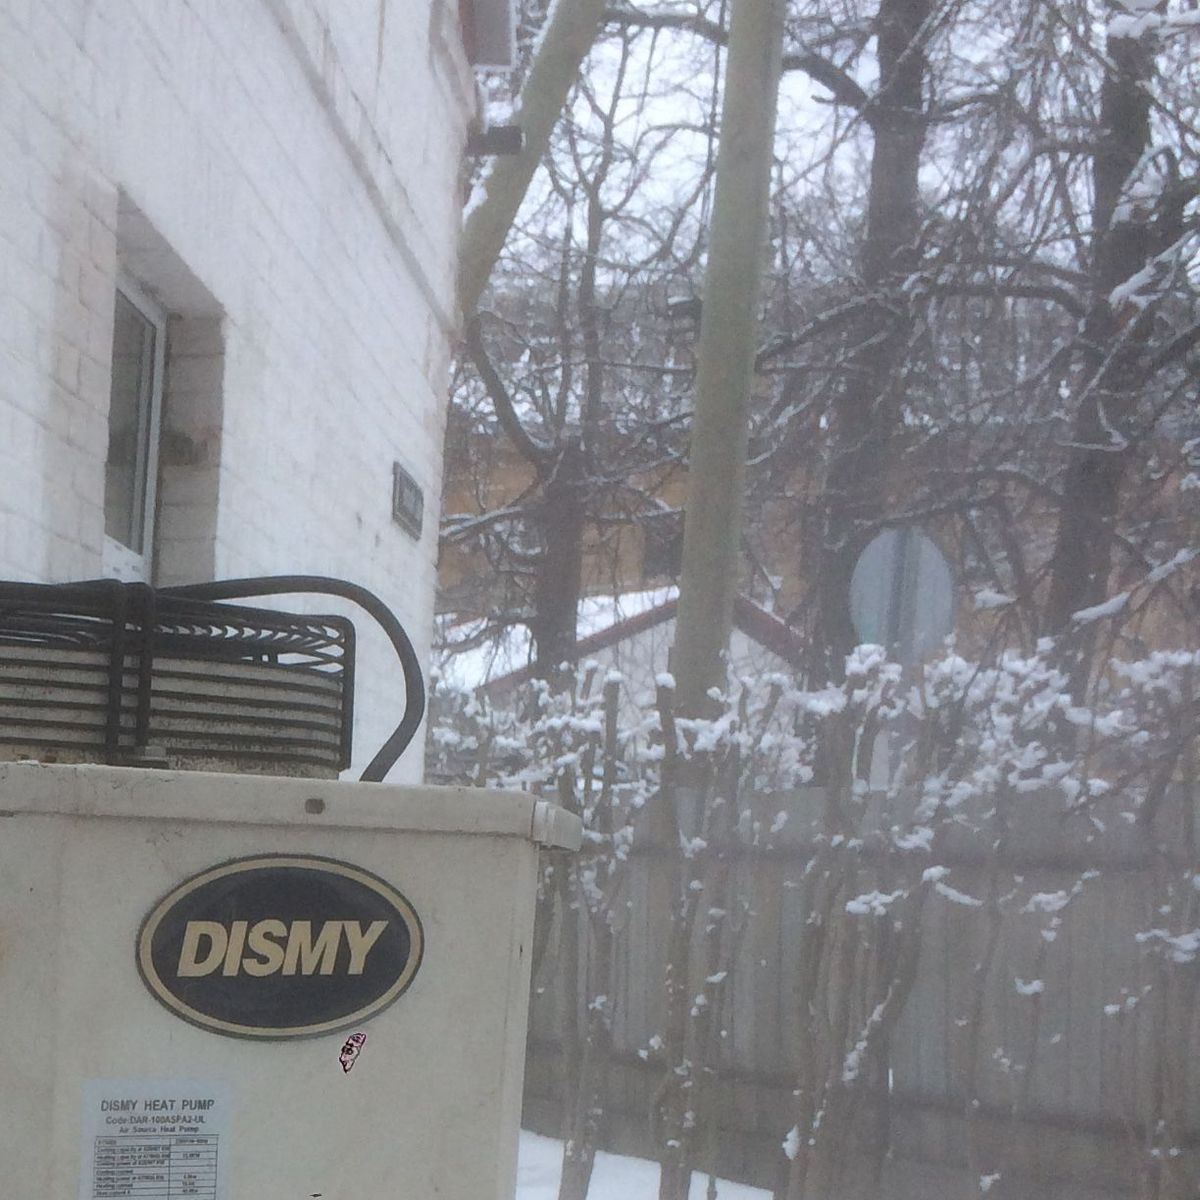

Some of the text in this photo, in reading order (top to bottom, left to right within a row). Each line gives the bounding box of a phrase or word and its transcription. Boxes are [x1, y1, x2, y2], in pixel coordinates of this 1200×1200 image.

[177, 919, 389, 977] DISMY
[100, 1099, 215, 1112] DISMY HEAT PUMP
